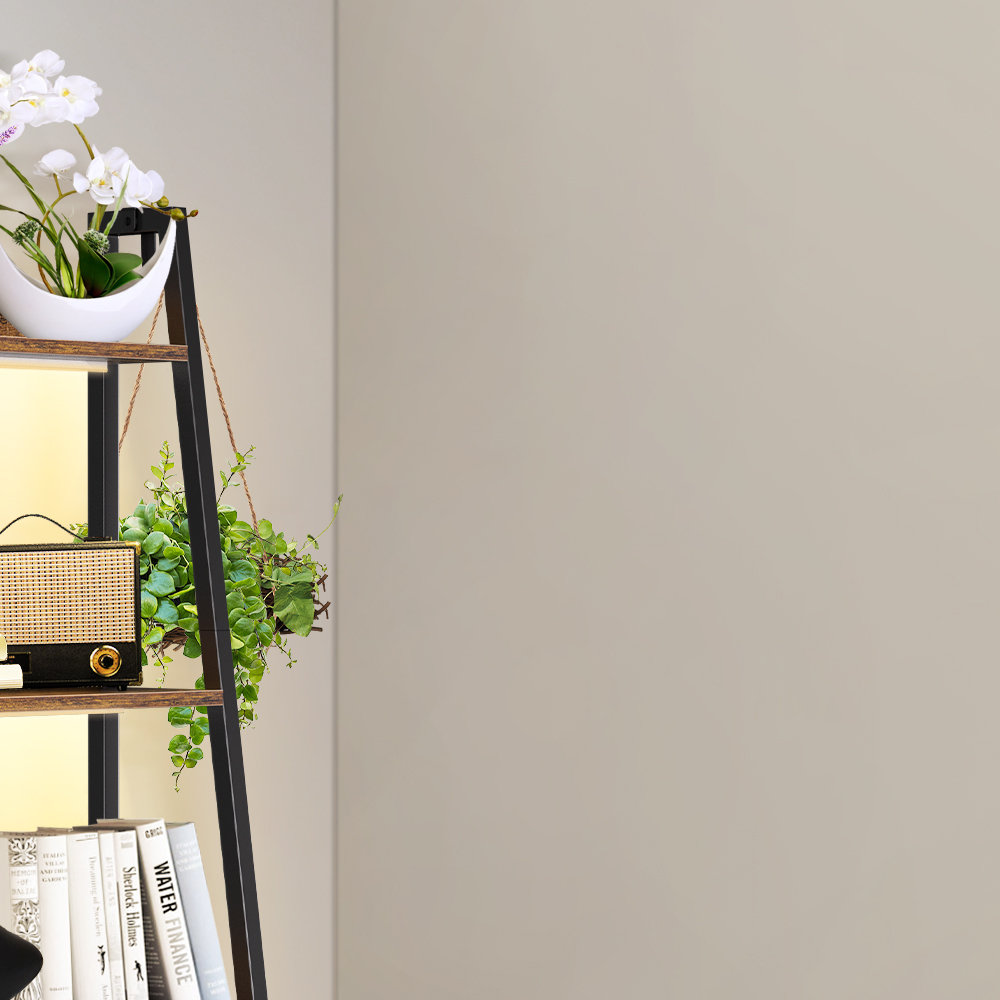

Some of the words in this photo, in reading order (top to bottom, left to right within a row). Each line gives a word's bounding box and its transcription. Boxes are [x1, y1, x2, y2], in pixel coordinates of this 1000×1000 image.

[122, 866, 139, 909] Sherlock
[153, 860, 178, 914] WATER
[126, 911, 141, 947] Holmes
[165, 917, 193, 986] FINANCE
